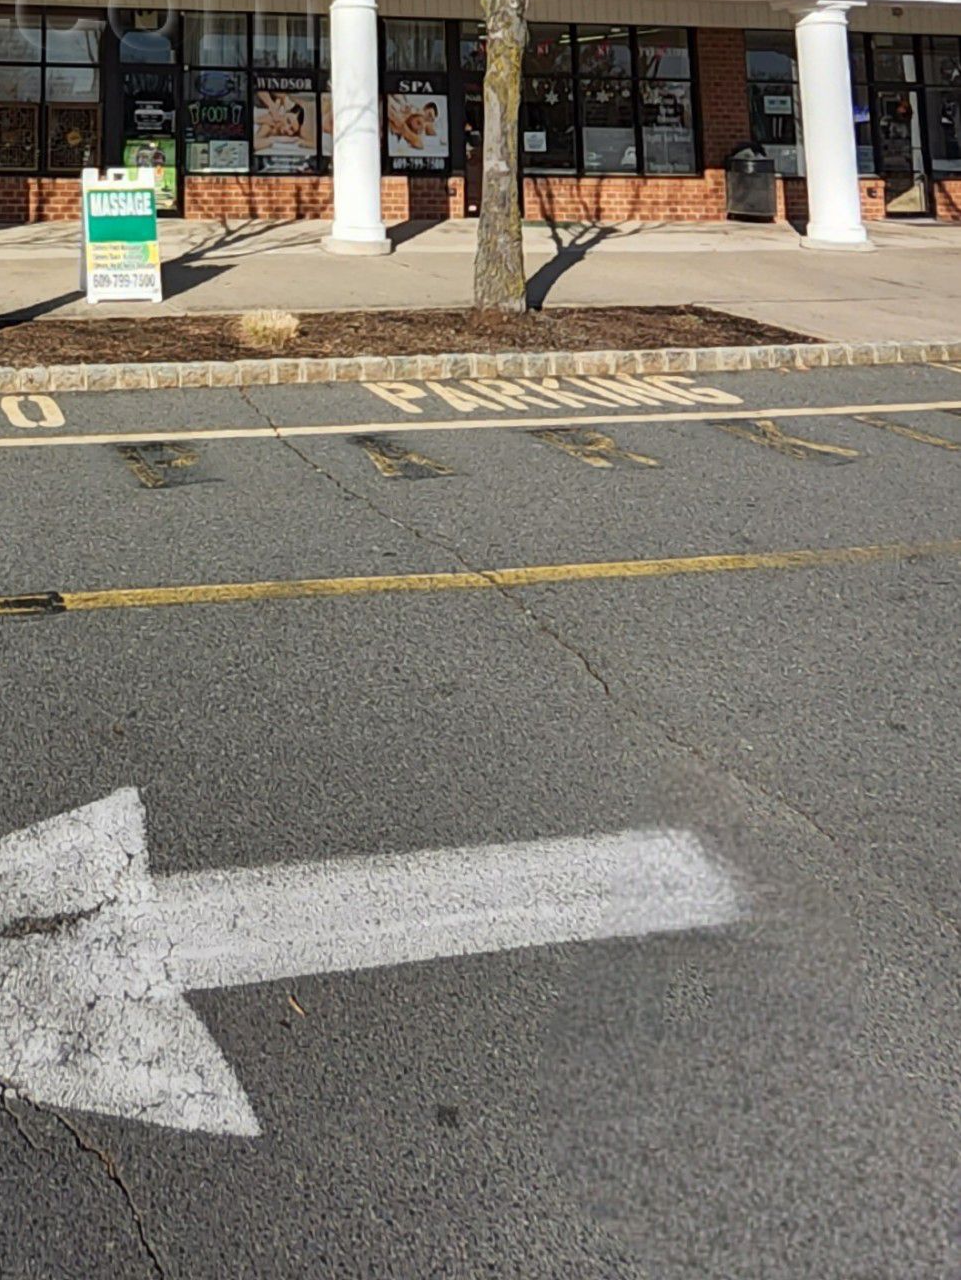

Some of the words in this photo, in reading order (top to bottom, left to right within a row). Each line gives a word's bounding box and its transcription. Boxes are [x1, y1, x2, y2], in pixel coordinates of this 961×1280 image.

[255, 77, 313, 91] WINDSOR
[398, 80, 434, 93] SPA
[201, 106, 228, 123] FOOT
[89, 192, 153, 217] MASSAGE
[362, 374, 744, 414] PARKING
